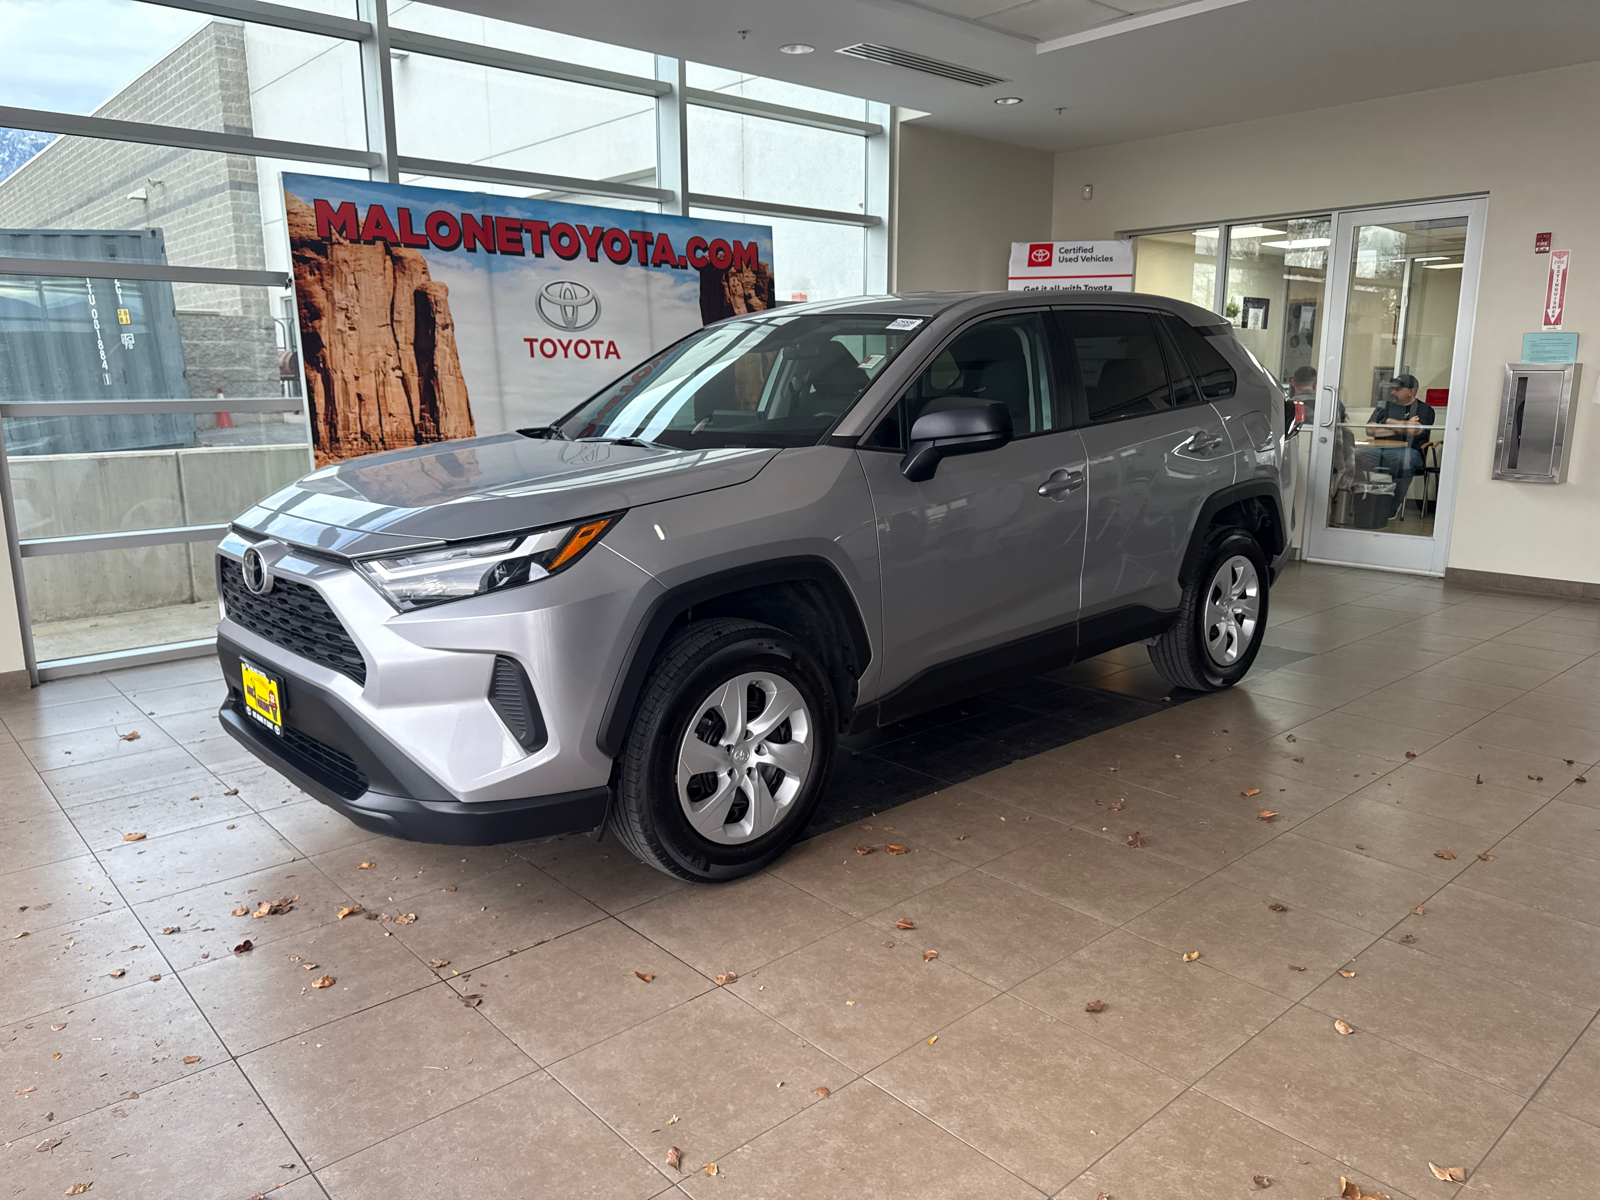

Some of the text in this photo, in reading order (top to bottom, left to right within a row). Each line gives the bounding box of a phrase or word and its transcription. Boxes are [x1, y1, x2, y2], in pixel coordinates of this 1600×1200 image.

[313, 199, 759, 271] MALONETOYOTA.COM
[1058, 246, 1094, 254] Certified
[1058, 254, 1114, 263] Used Vehicles
[523, 338, 621, 360] TOYOTA
